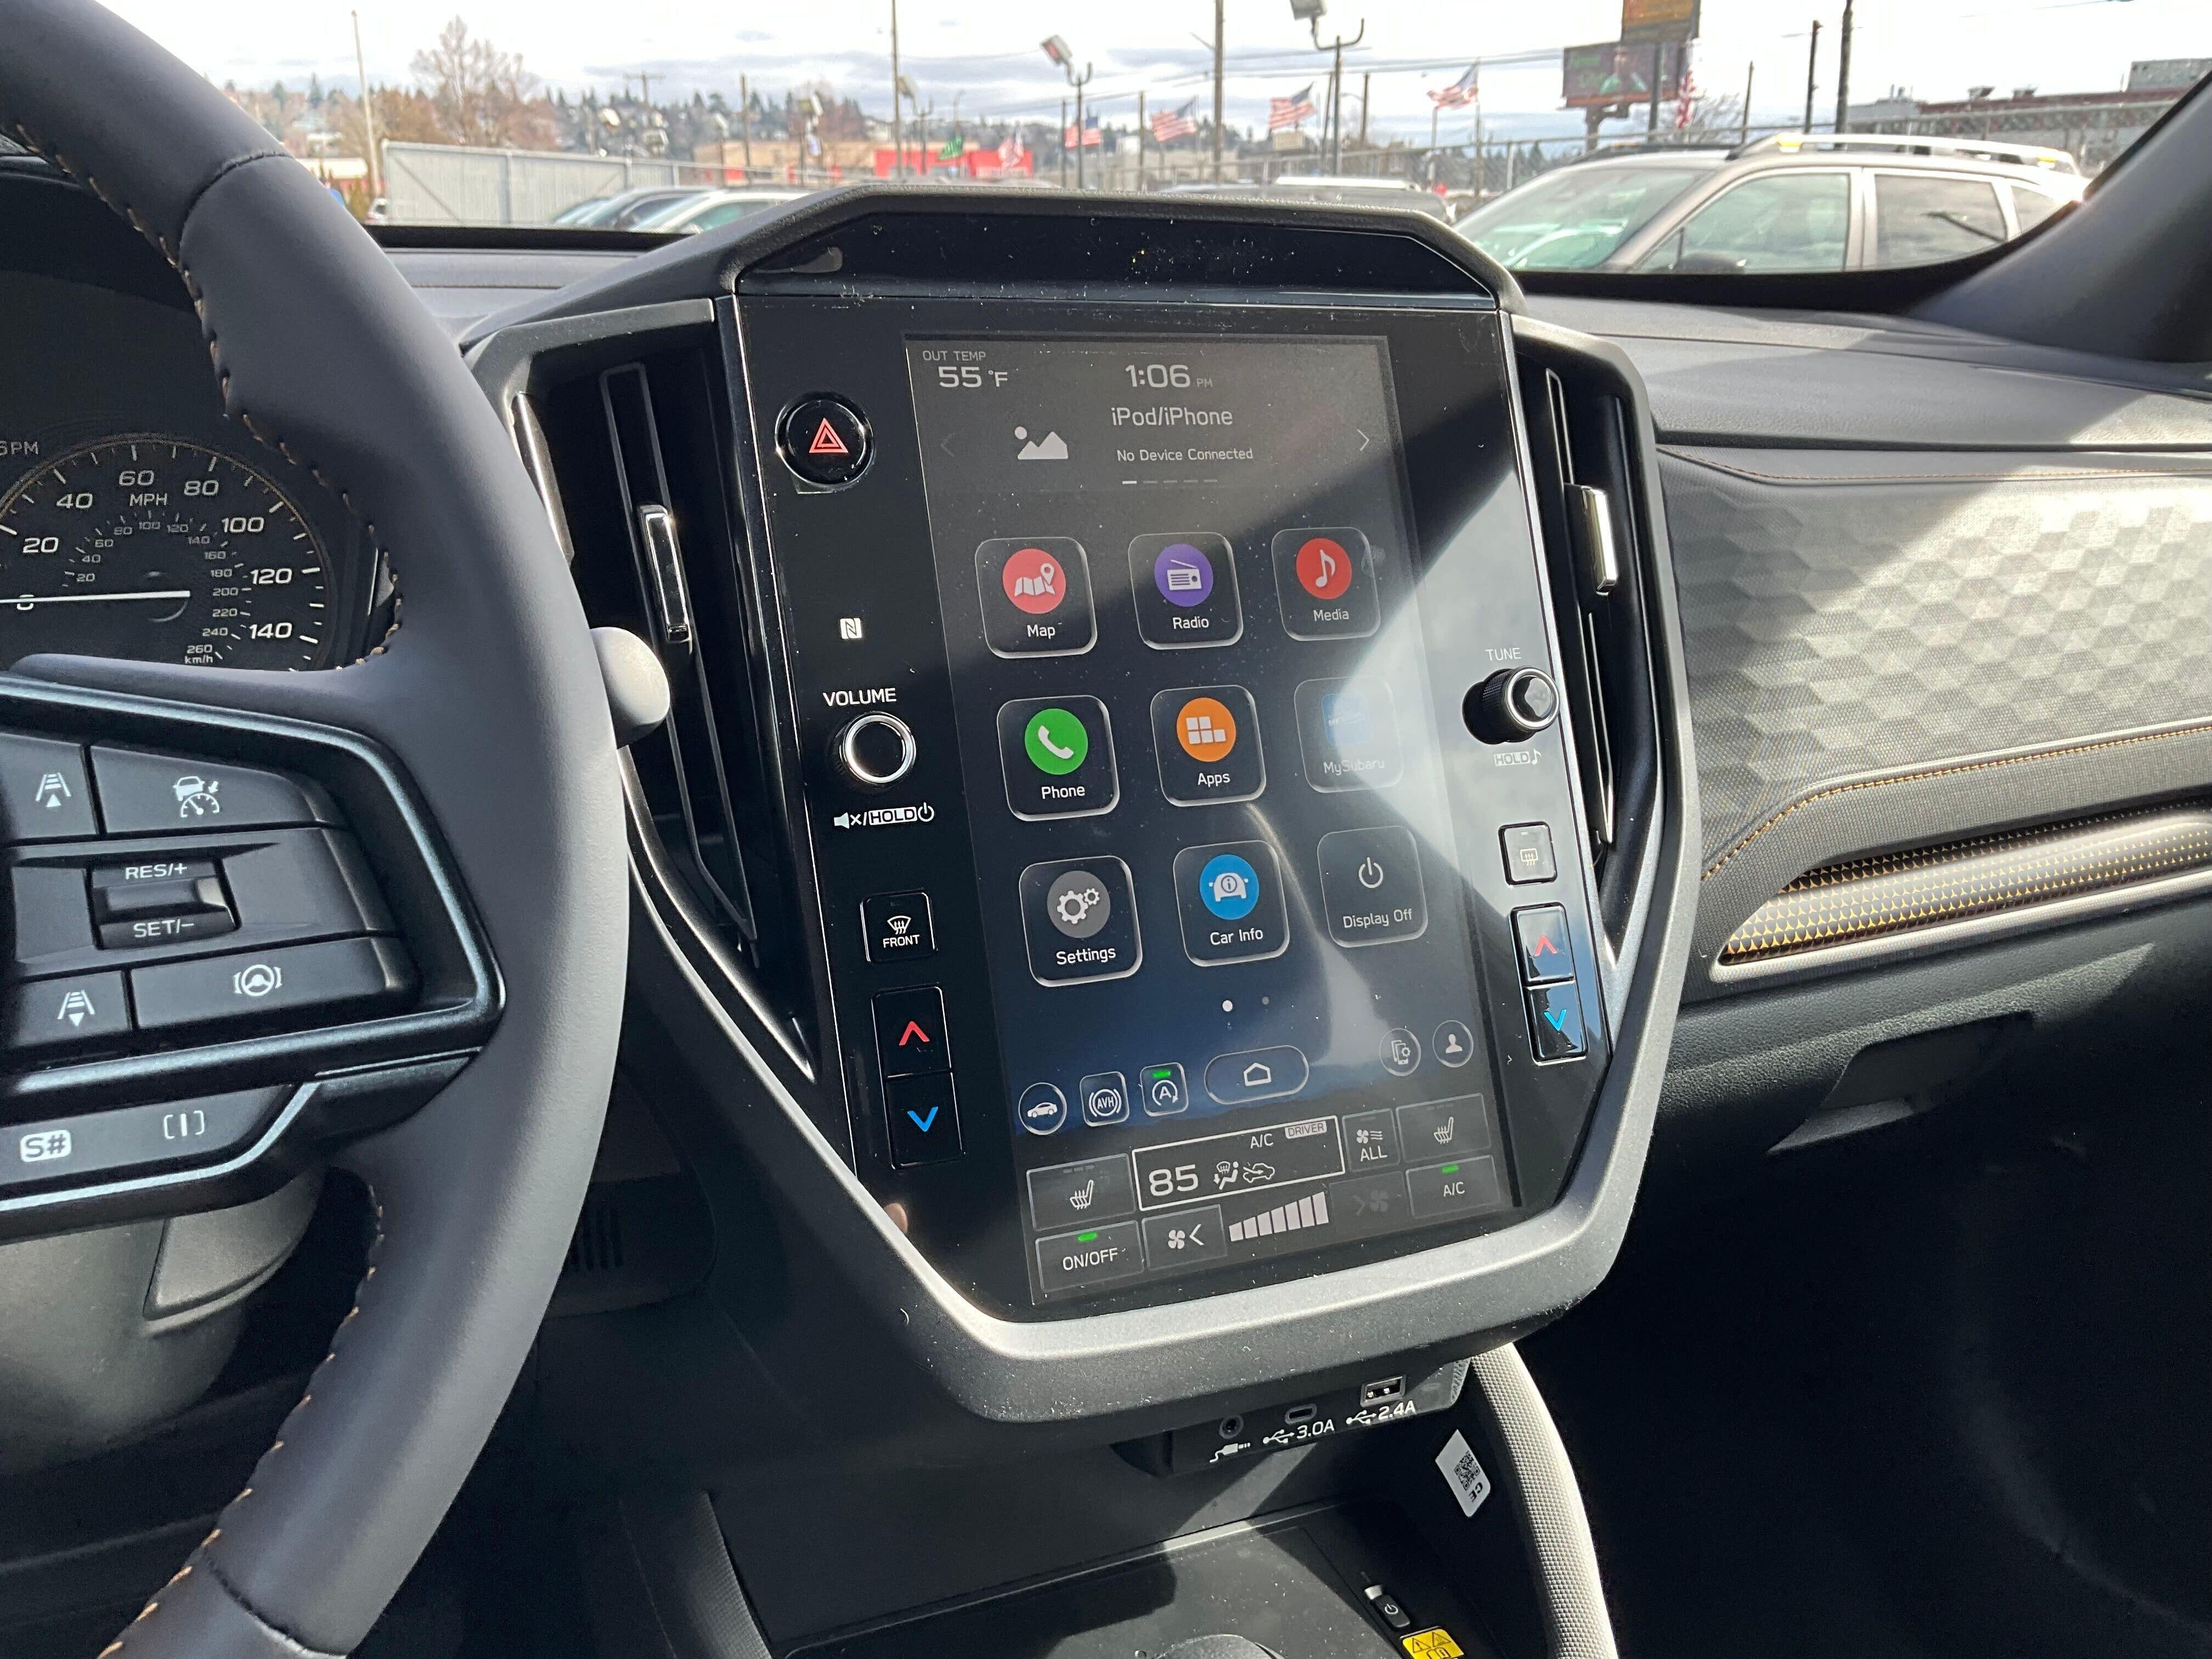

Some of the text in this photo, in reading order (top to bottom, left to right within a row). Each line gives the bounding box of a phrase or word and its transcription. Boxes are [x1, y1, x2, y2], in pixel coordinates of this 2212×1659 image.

[922, 350, 986, 362] OUT TEMP
[938, 366, 982, 387] 55
[1125, 364, 1213, 388] 1:06 PM
[1111, 407, 1233, 426] iPod/iPhone
[1117, 447, 1253, 461] No Device Connected
[119, 470, 154, 486] 60
[184, 480, 219, 496] 80
[56, 493, 93, 509] 40
[129, 494, 167, 506] MPH
[222, 517, 264, 533] 100
[22, 537, 59, 554] 20
[95, 539, 114, 548] 60
[188, 536, 210, 545] 140
[82, 554, 101, 563] 40
[204, 551, 227, 560] 160
[76, 573, 95, 582] 20
[210, 569, 233, 578] 180
[250, 568, 292, 585] 120
[212, 587, 238, 596] 200
[212, 608, 238, 617] 220
[1313, 608, 1349, 622] Media
[249, 622, 292, 640] 140
[1027, 624, 1056, 639] Map
[1172, 617, 1209, 630] Radio
[202, 628, 228, 637] 240
[187, 644, 213, 654] 260
[1485, 647, 1522, 661] TUNE
[184, 654, 213, 664] km/h
[822, 687, 897, 707] VOLUME
[1495, 752, 1530, 766] HOLD
[1323, 759, 1385, 776] MySubaru
[1198, 773, 1231, 787] Apps
[1041, 786, 1085, 799] Phone
[870, 808, 916, 824] HOLD
[125, 863, 188, 880] RES/+
[1342, 908, 1412, 928] Display Off
[883, 934, 920, 948] FRONT
[1210, 928, 1263, 946] Car Info
[1056, 947, 1116, 966] Settings
[1097, 1096, 1115, 1110] AVH
[1288, 1122, 1324, 1137] DRIVER
[25, 1133, 66, 1159] S#
[1250, 1133, 1274, 1149] A/C
[1360, 1145, 1387, 1162] ALL
[1148, 1164, 1199, 1197] 85
[1443, 1181, 1465, 1197] A/C
[1063, 1247, 1118, 1271] ON/OFF
[1378, 1400, 1416, 1420] 2.4A
[1296, 1419, 1335, 1439] 3.0A
